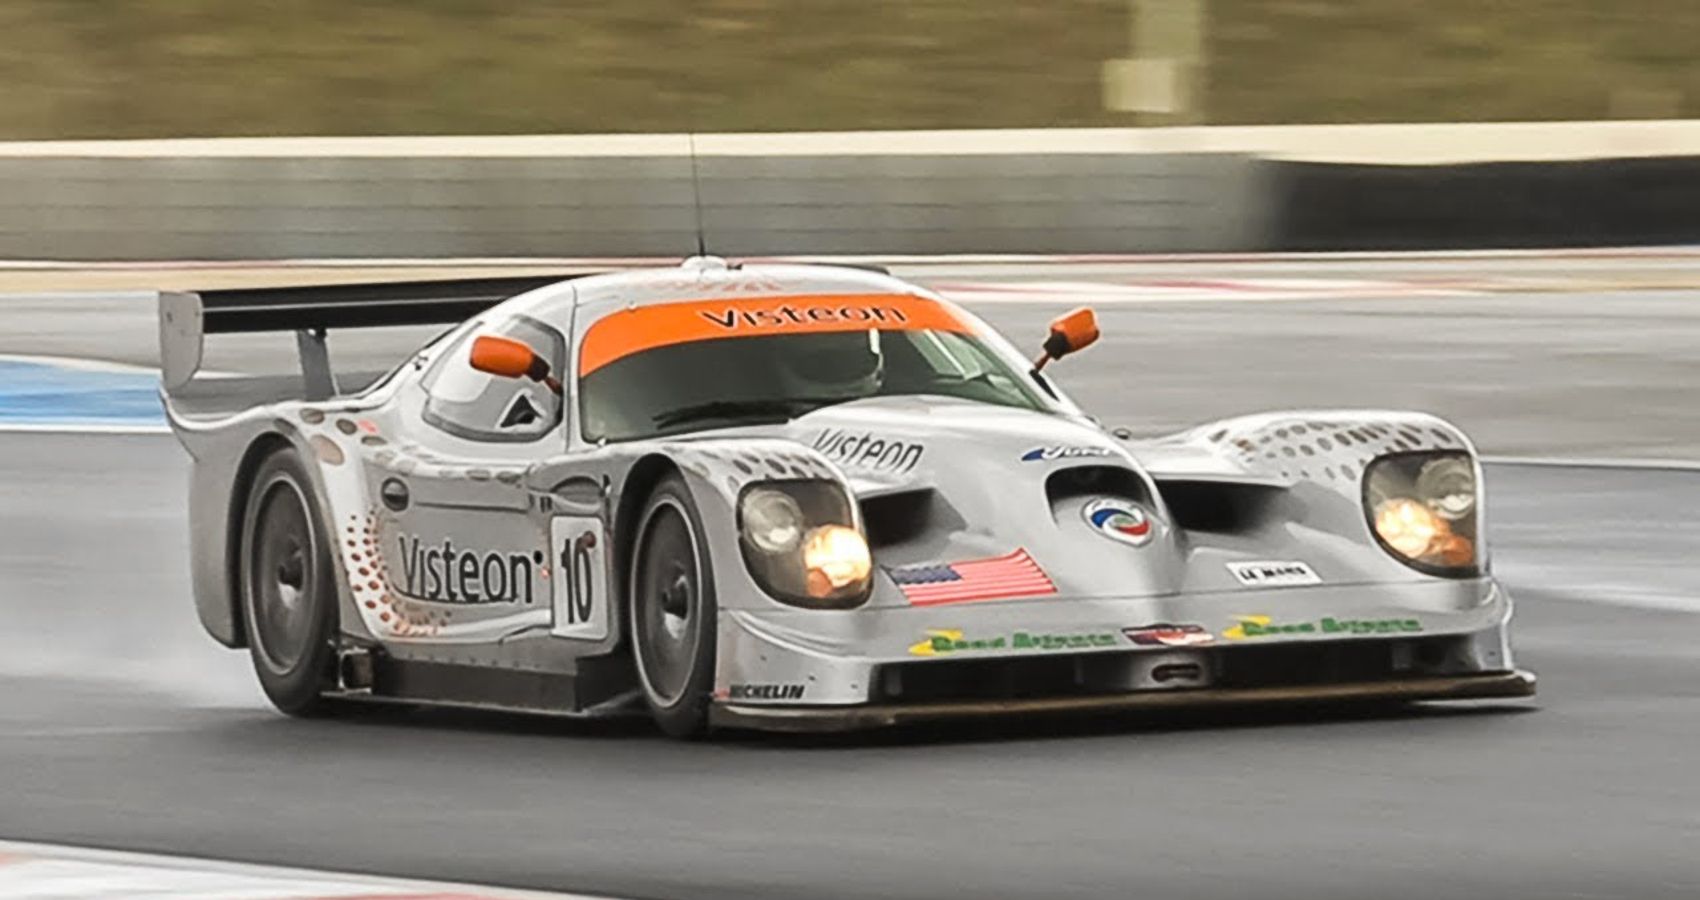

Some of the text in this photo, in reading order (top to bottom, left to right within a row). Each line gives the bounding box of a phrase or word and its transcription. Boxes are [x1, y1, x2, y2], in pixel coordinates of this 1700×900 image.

[699, 304, 907, 328] Visteon
[812, 427, 925, 473] Visteon
[398, 535, 534, 604] Visteon
[561, 537, 593, 625] 10
